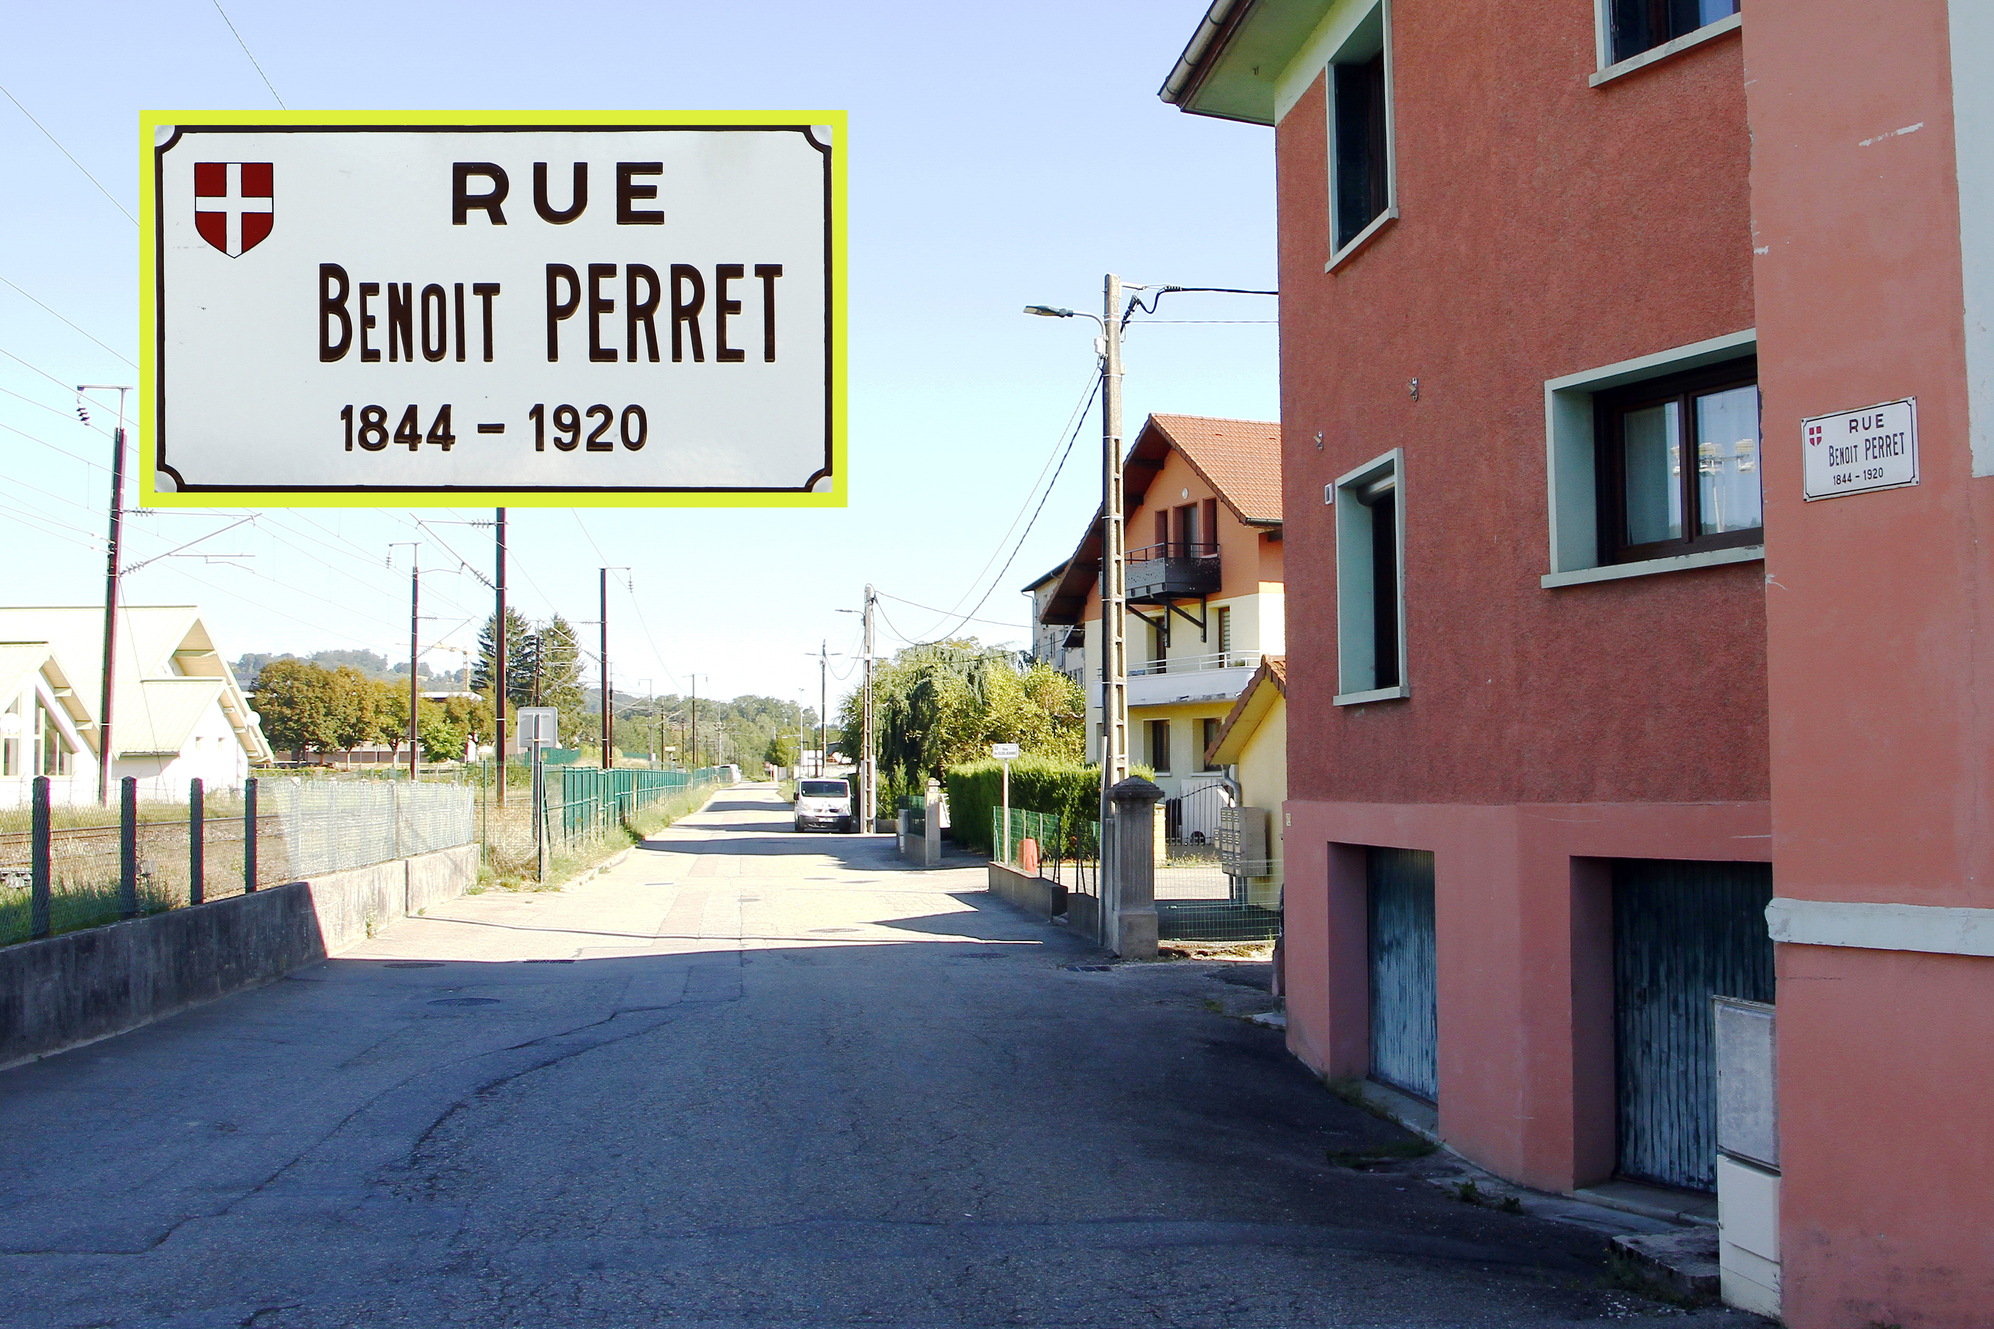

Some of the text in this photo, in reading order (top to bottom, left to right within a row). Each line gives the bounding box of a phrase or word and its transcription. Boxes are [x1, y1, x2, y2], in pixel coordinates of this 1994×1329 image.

[452, 161, 665, 226] RUE
[319, 262, 783, 364] BENOIT PERRET
[340, 403, 456, 452] 1844
[528, 403, 648, 452] 1920
[1849, 413, 1885, 434] RUE
[1829, 432, 1905, 467] BENOIT PERRET
[1833, 472, 1853, 486] 1844
[1863, 467, 1884, 481] 1920
